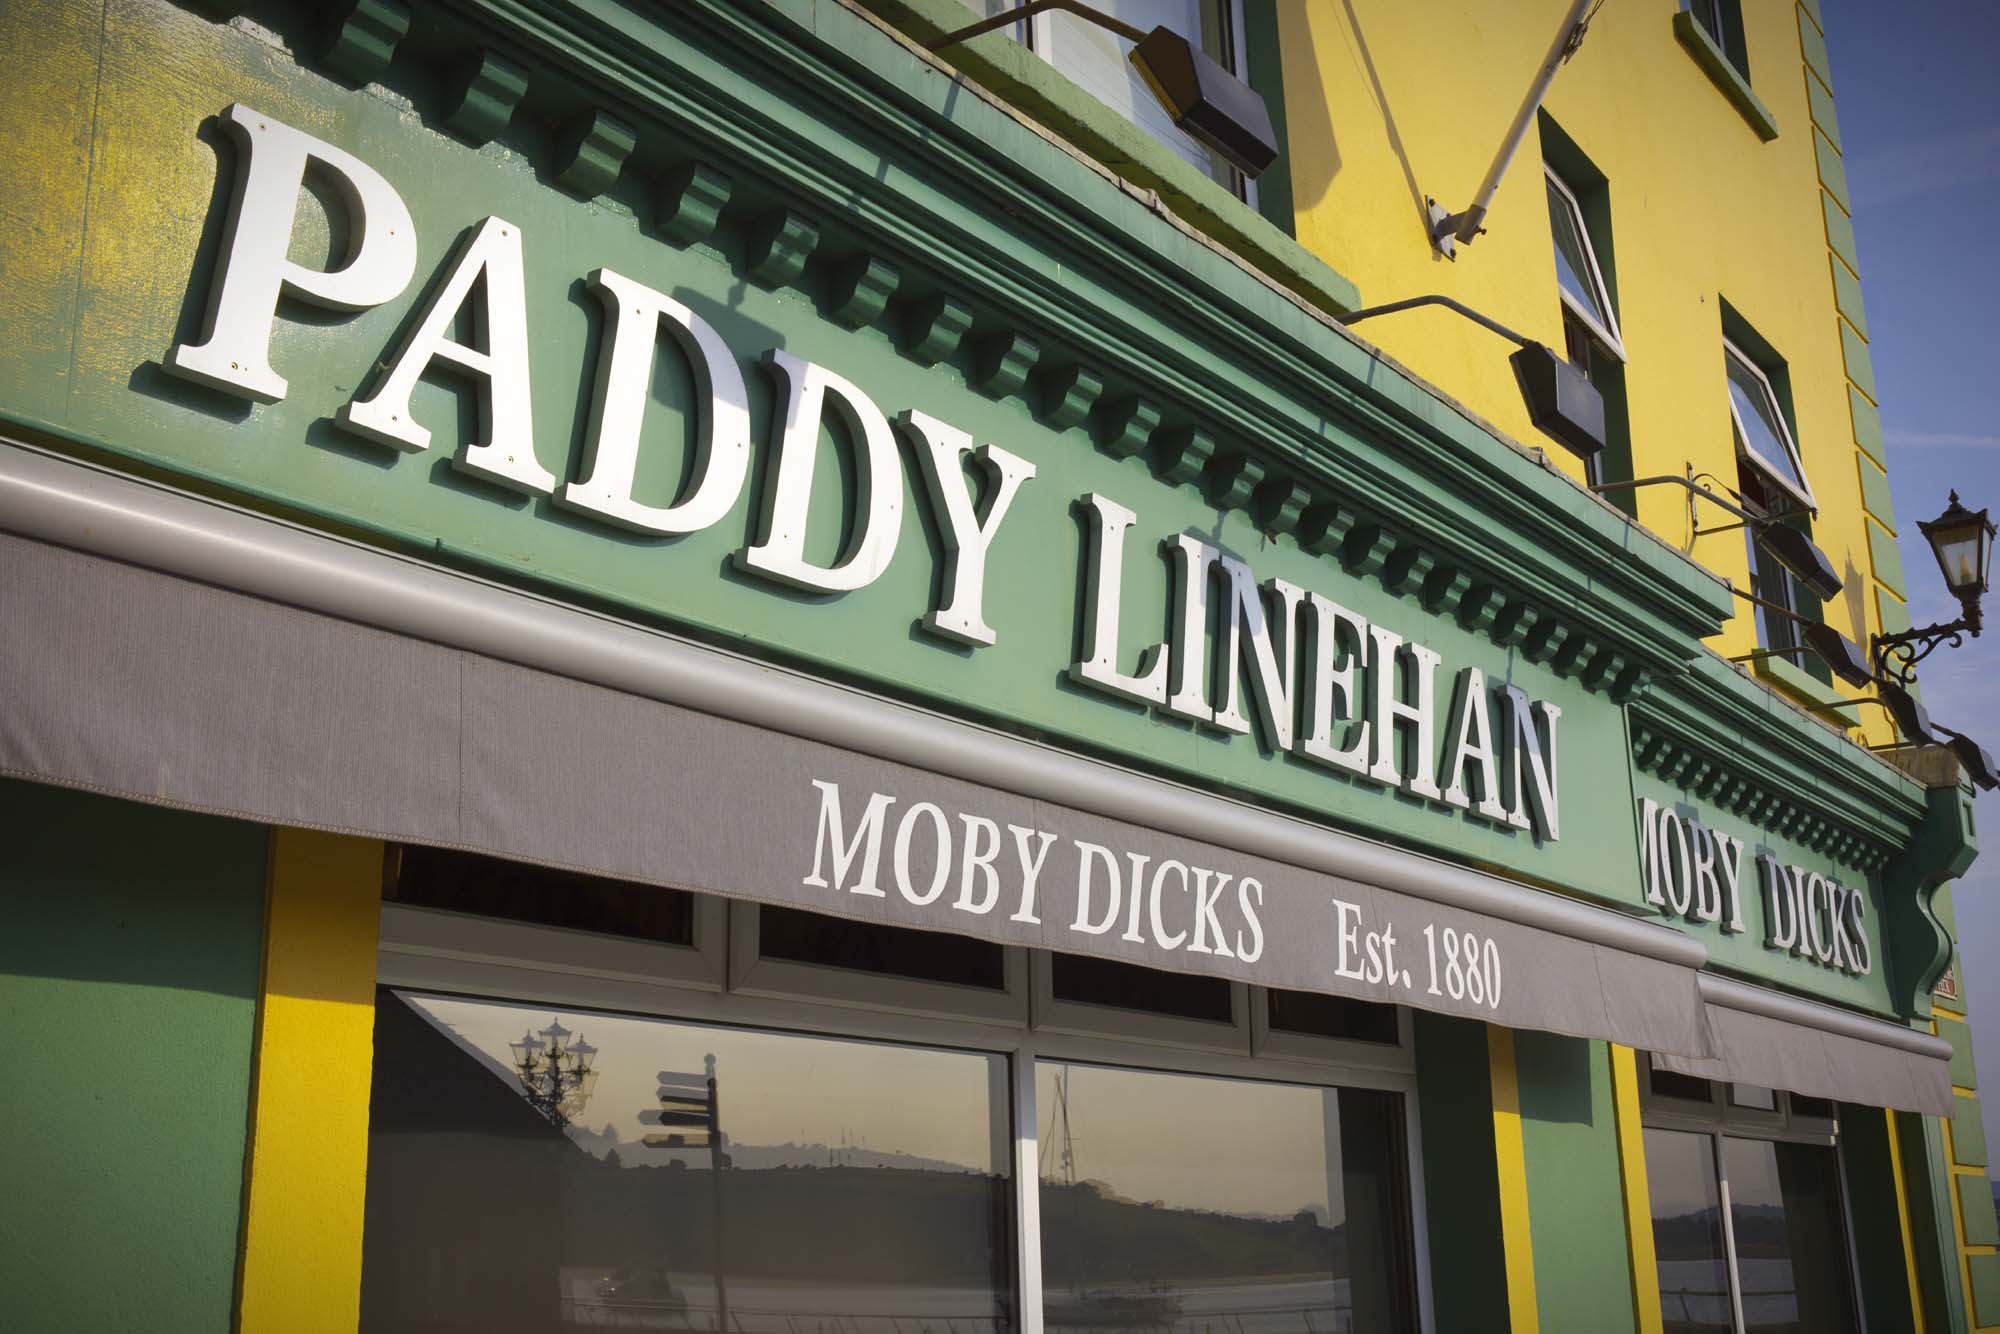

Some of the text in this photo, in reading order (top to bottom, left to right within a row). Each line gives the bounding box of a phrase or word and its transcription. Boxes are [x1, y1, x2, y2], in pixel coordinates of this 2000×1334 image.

[165, 103, 1562, 842] PADDY LINEHAN
[803, 780, 1502, 1009] MOBY DICKS Est. 1880
[1759, 854, 1872, 975] DICKS
